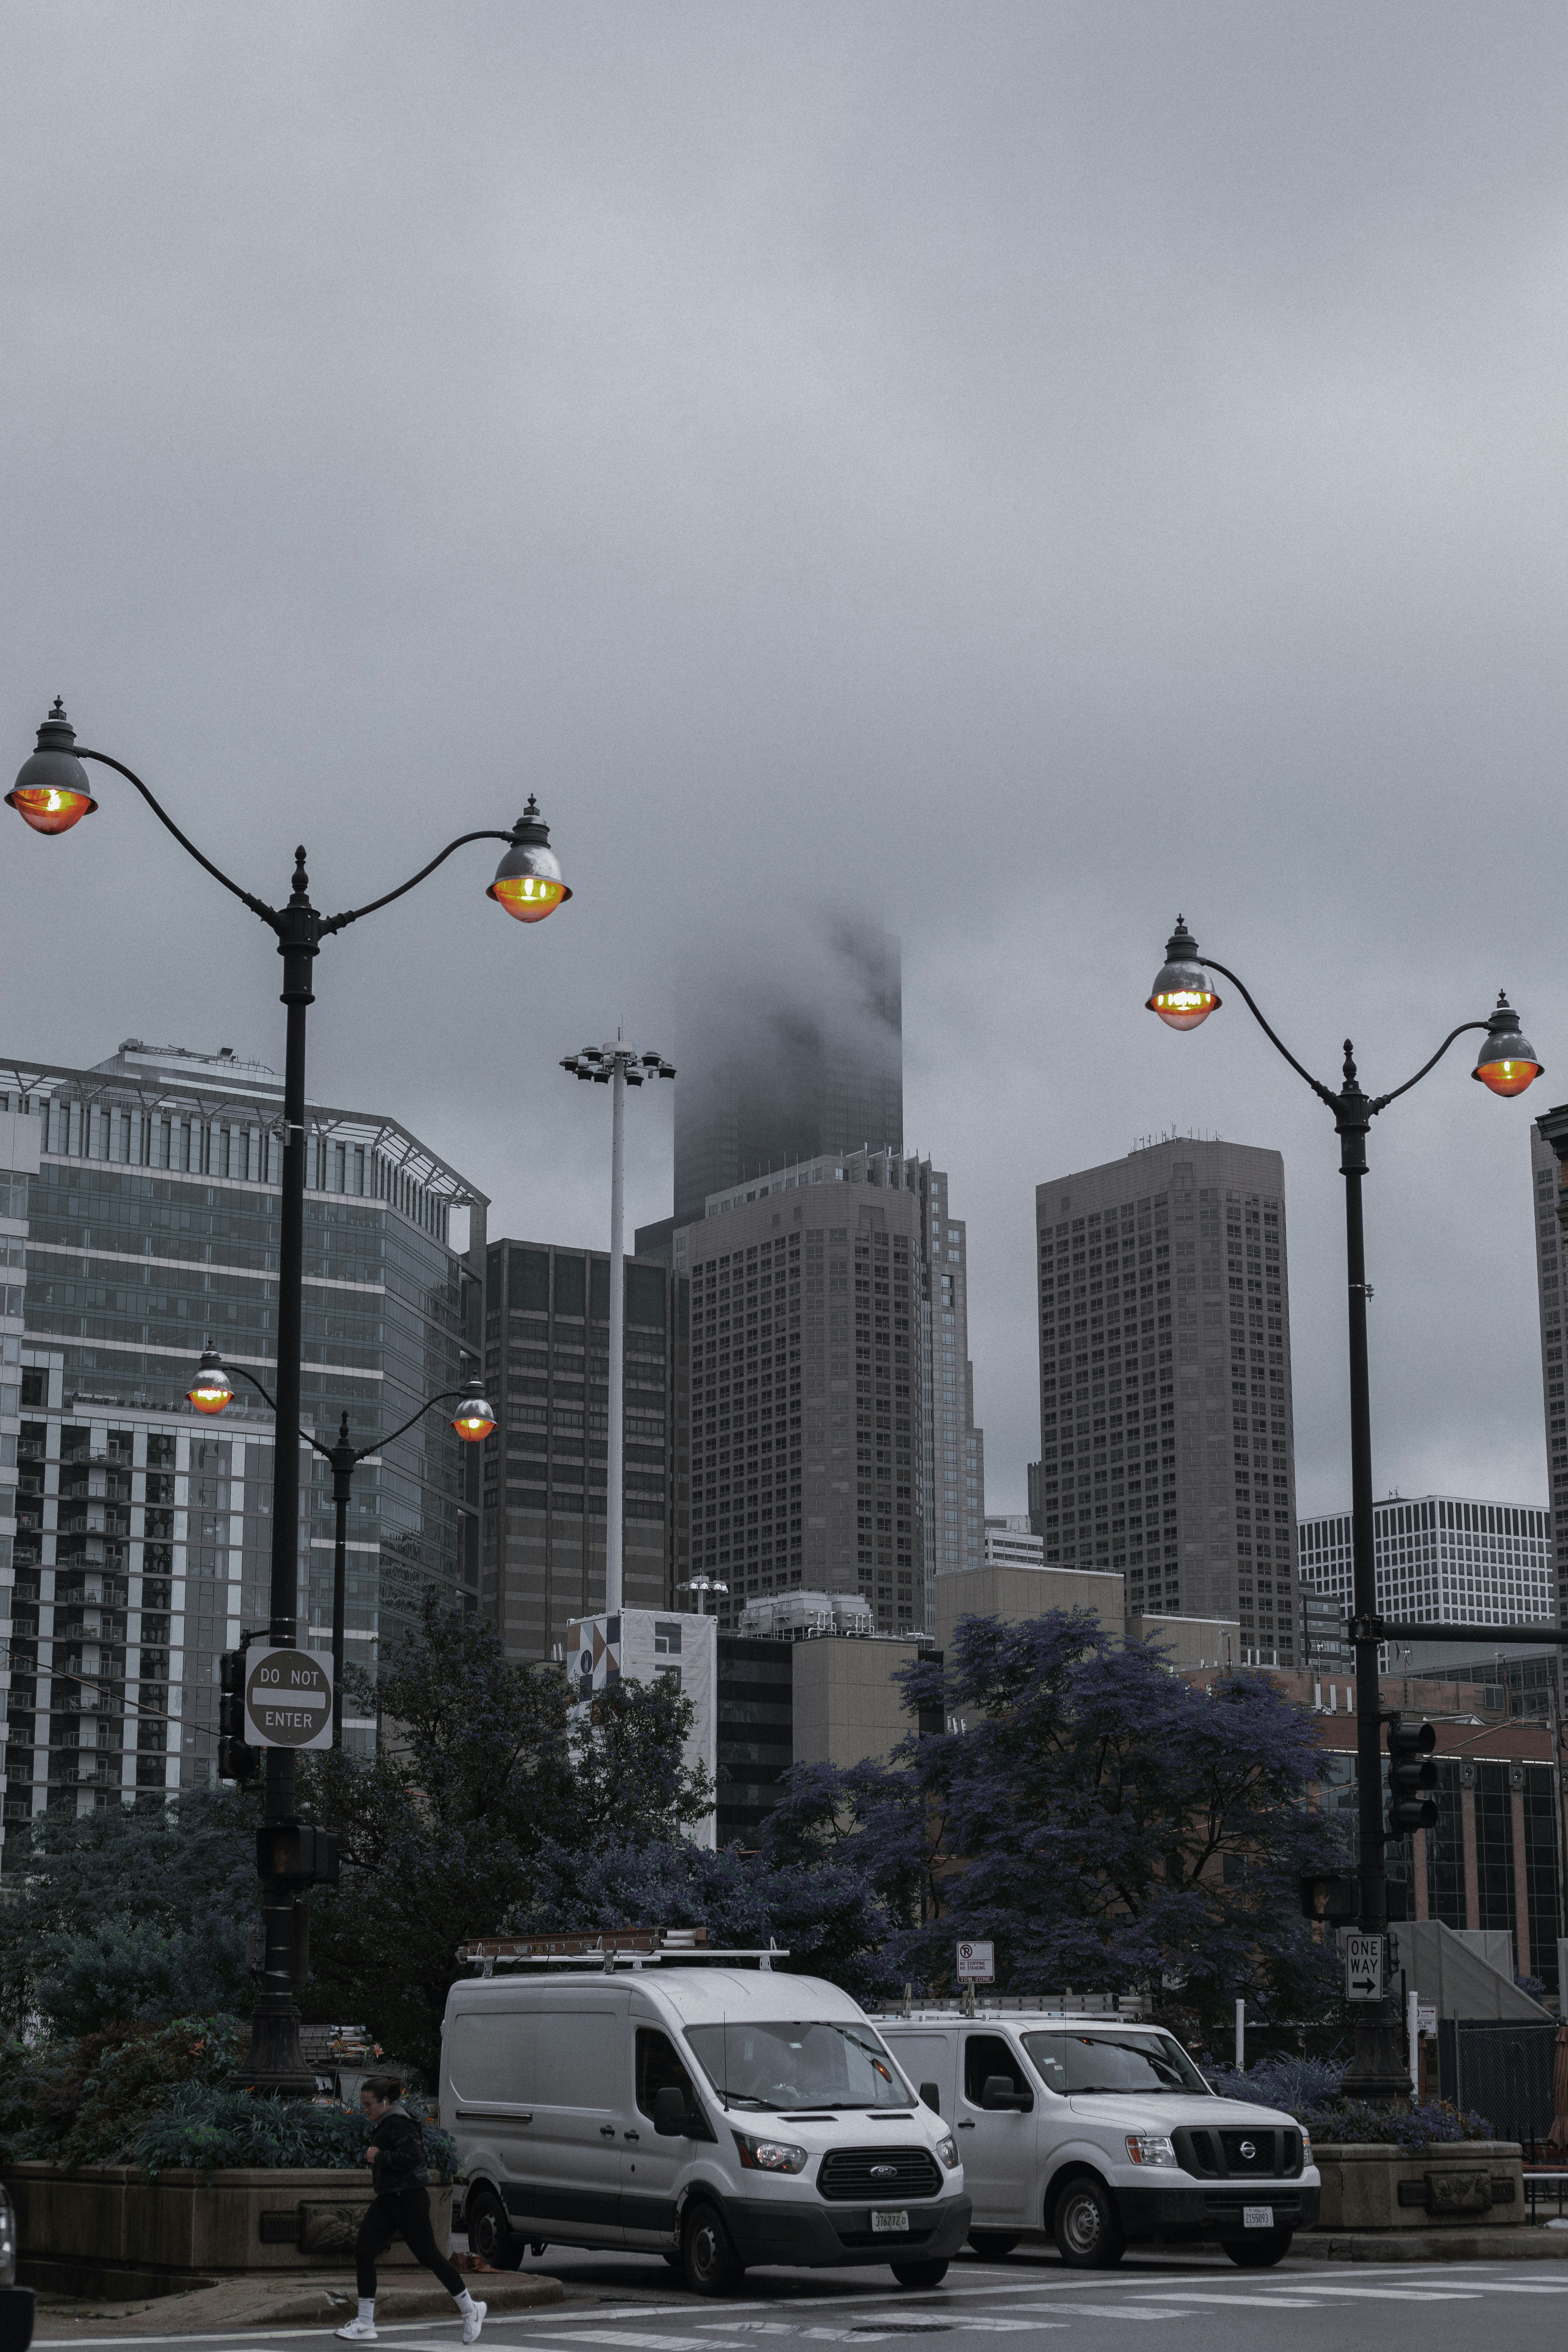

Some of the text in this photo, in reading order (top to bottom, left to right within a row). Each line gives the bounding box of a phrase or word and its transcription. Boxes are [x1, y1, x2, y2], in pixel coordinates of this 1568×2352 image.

[260, 1668, 319, 1686] DO NOT
[266, 1711, 312, 1728] ENTER
[1351, 1940, 1378, 1956] ONE
[1350, 1959, 1378, 1974] WAY
[876, 2216, 900, 2227] 376272
[1246, 2213, 1269, 2224] 2155093
